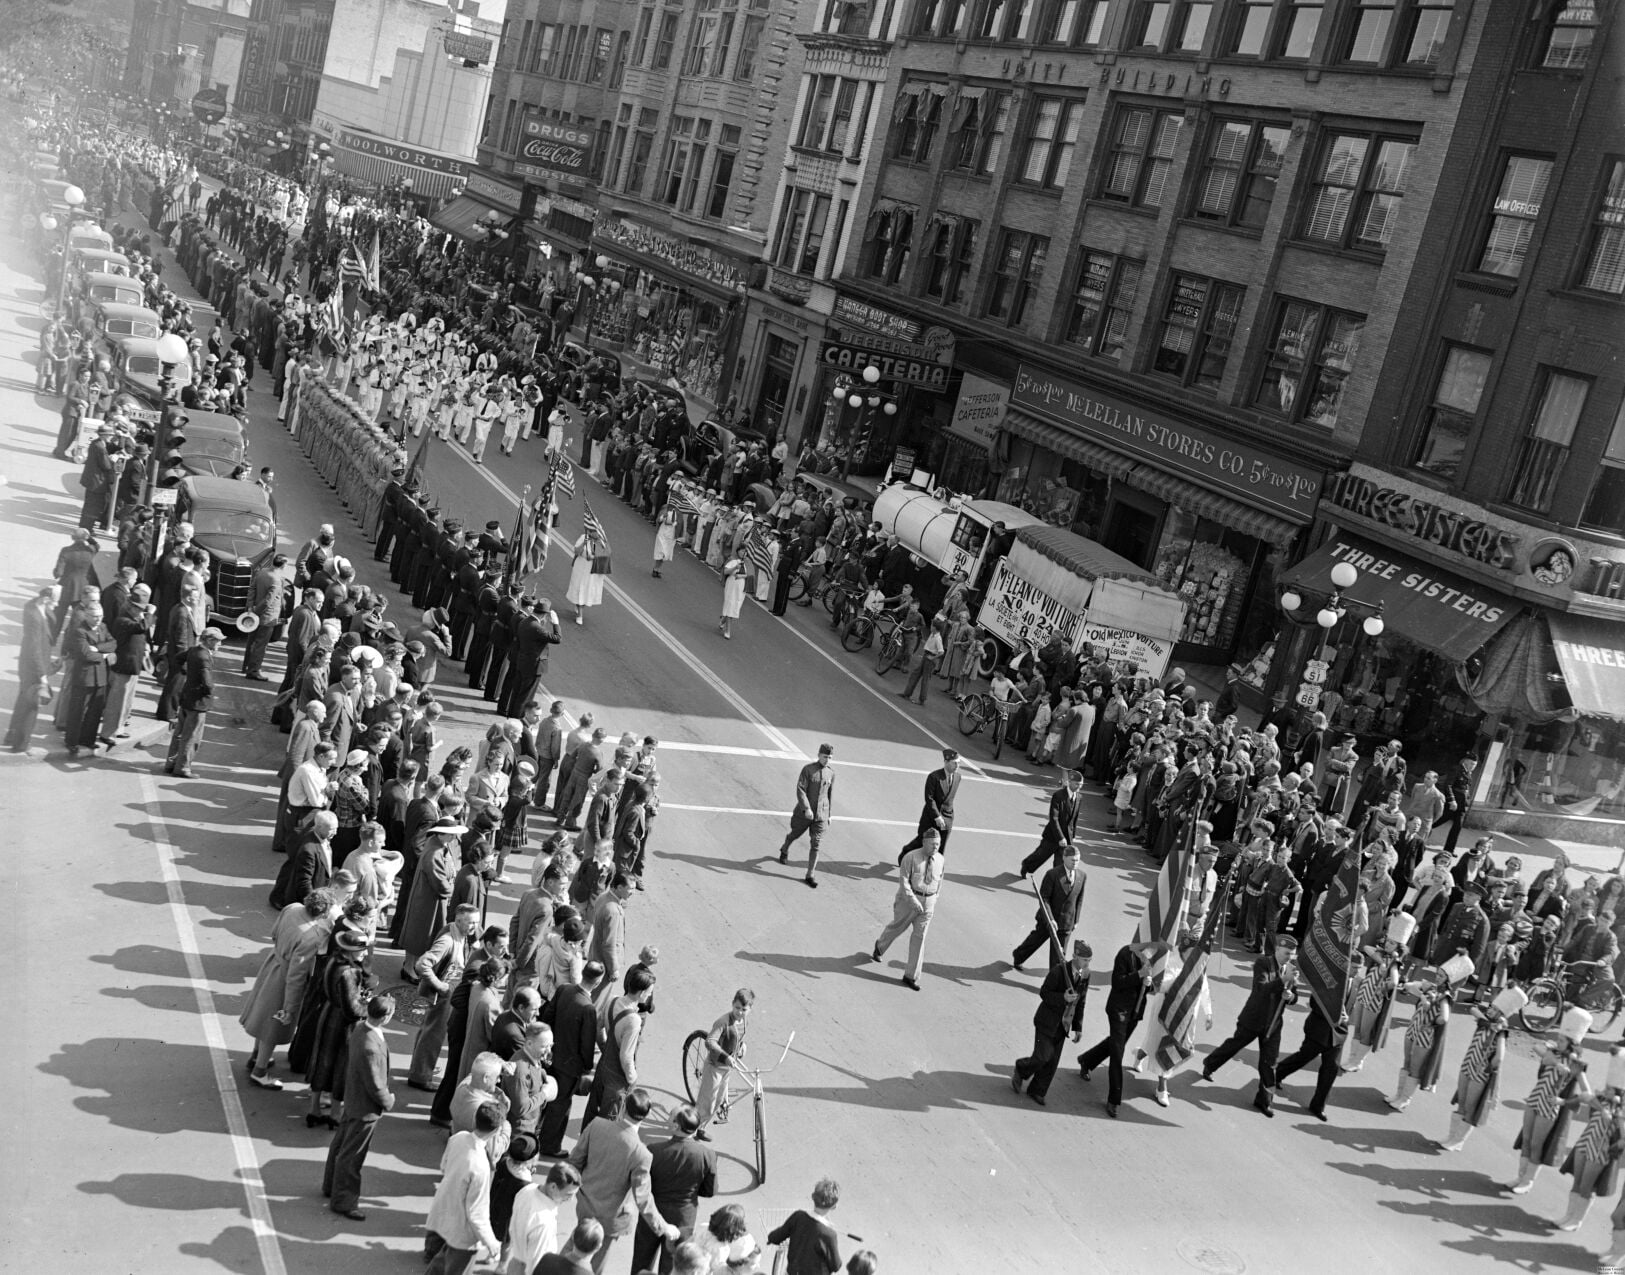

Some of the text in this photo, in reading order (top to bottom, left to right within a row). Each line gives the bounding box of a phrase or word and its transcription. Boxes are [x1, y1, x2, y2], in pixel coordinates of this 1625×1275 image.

[1002, 59, 1231, 96] UNITY BUILDING
[528, 122, 589, 145] DRUGS
[345, 134, 463, 174] WOOLWORTH
[1494, 197, 1541, 216] LAW OFFICES
[869, 308, 887, 323] BOOT
[888, 316, 908, 330] SHOP
[825, 346, 945, 386] CAFETERIA
[958, 407, 999, 421] CAFETERIA
[1146, 423, 1216, 464] STORES
[1219, 450, 1245, 477] CO.
[1332, 471, 1515, 567] THREE SISTERS
[954, 551, 967, 567] 40
[1329, 542, 1505, 624] THREE SISTERS
[1021, 610, 1036, 627] 40
[1019, 626, 1029, 638] 8
[1090, 629, 1106, 642] Old
[1107, 630, 1135, 641] Mexico
[1136, 632, 1163, 657] VOITURE
[1555, 639, 1625, 669] THREE
[1309, 671, 1321, 682] 51
[1300, 694, 1314, 705] 66
[1321, 940, 1345, 966] FOREIG
